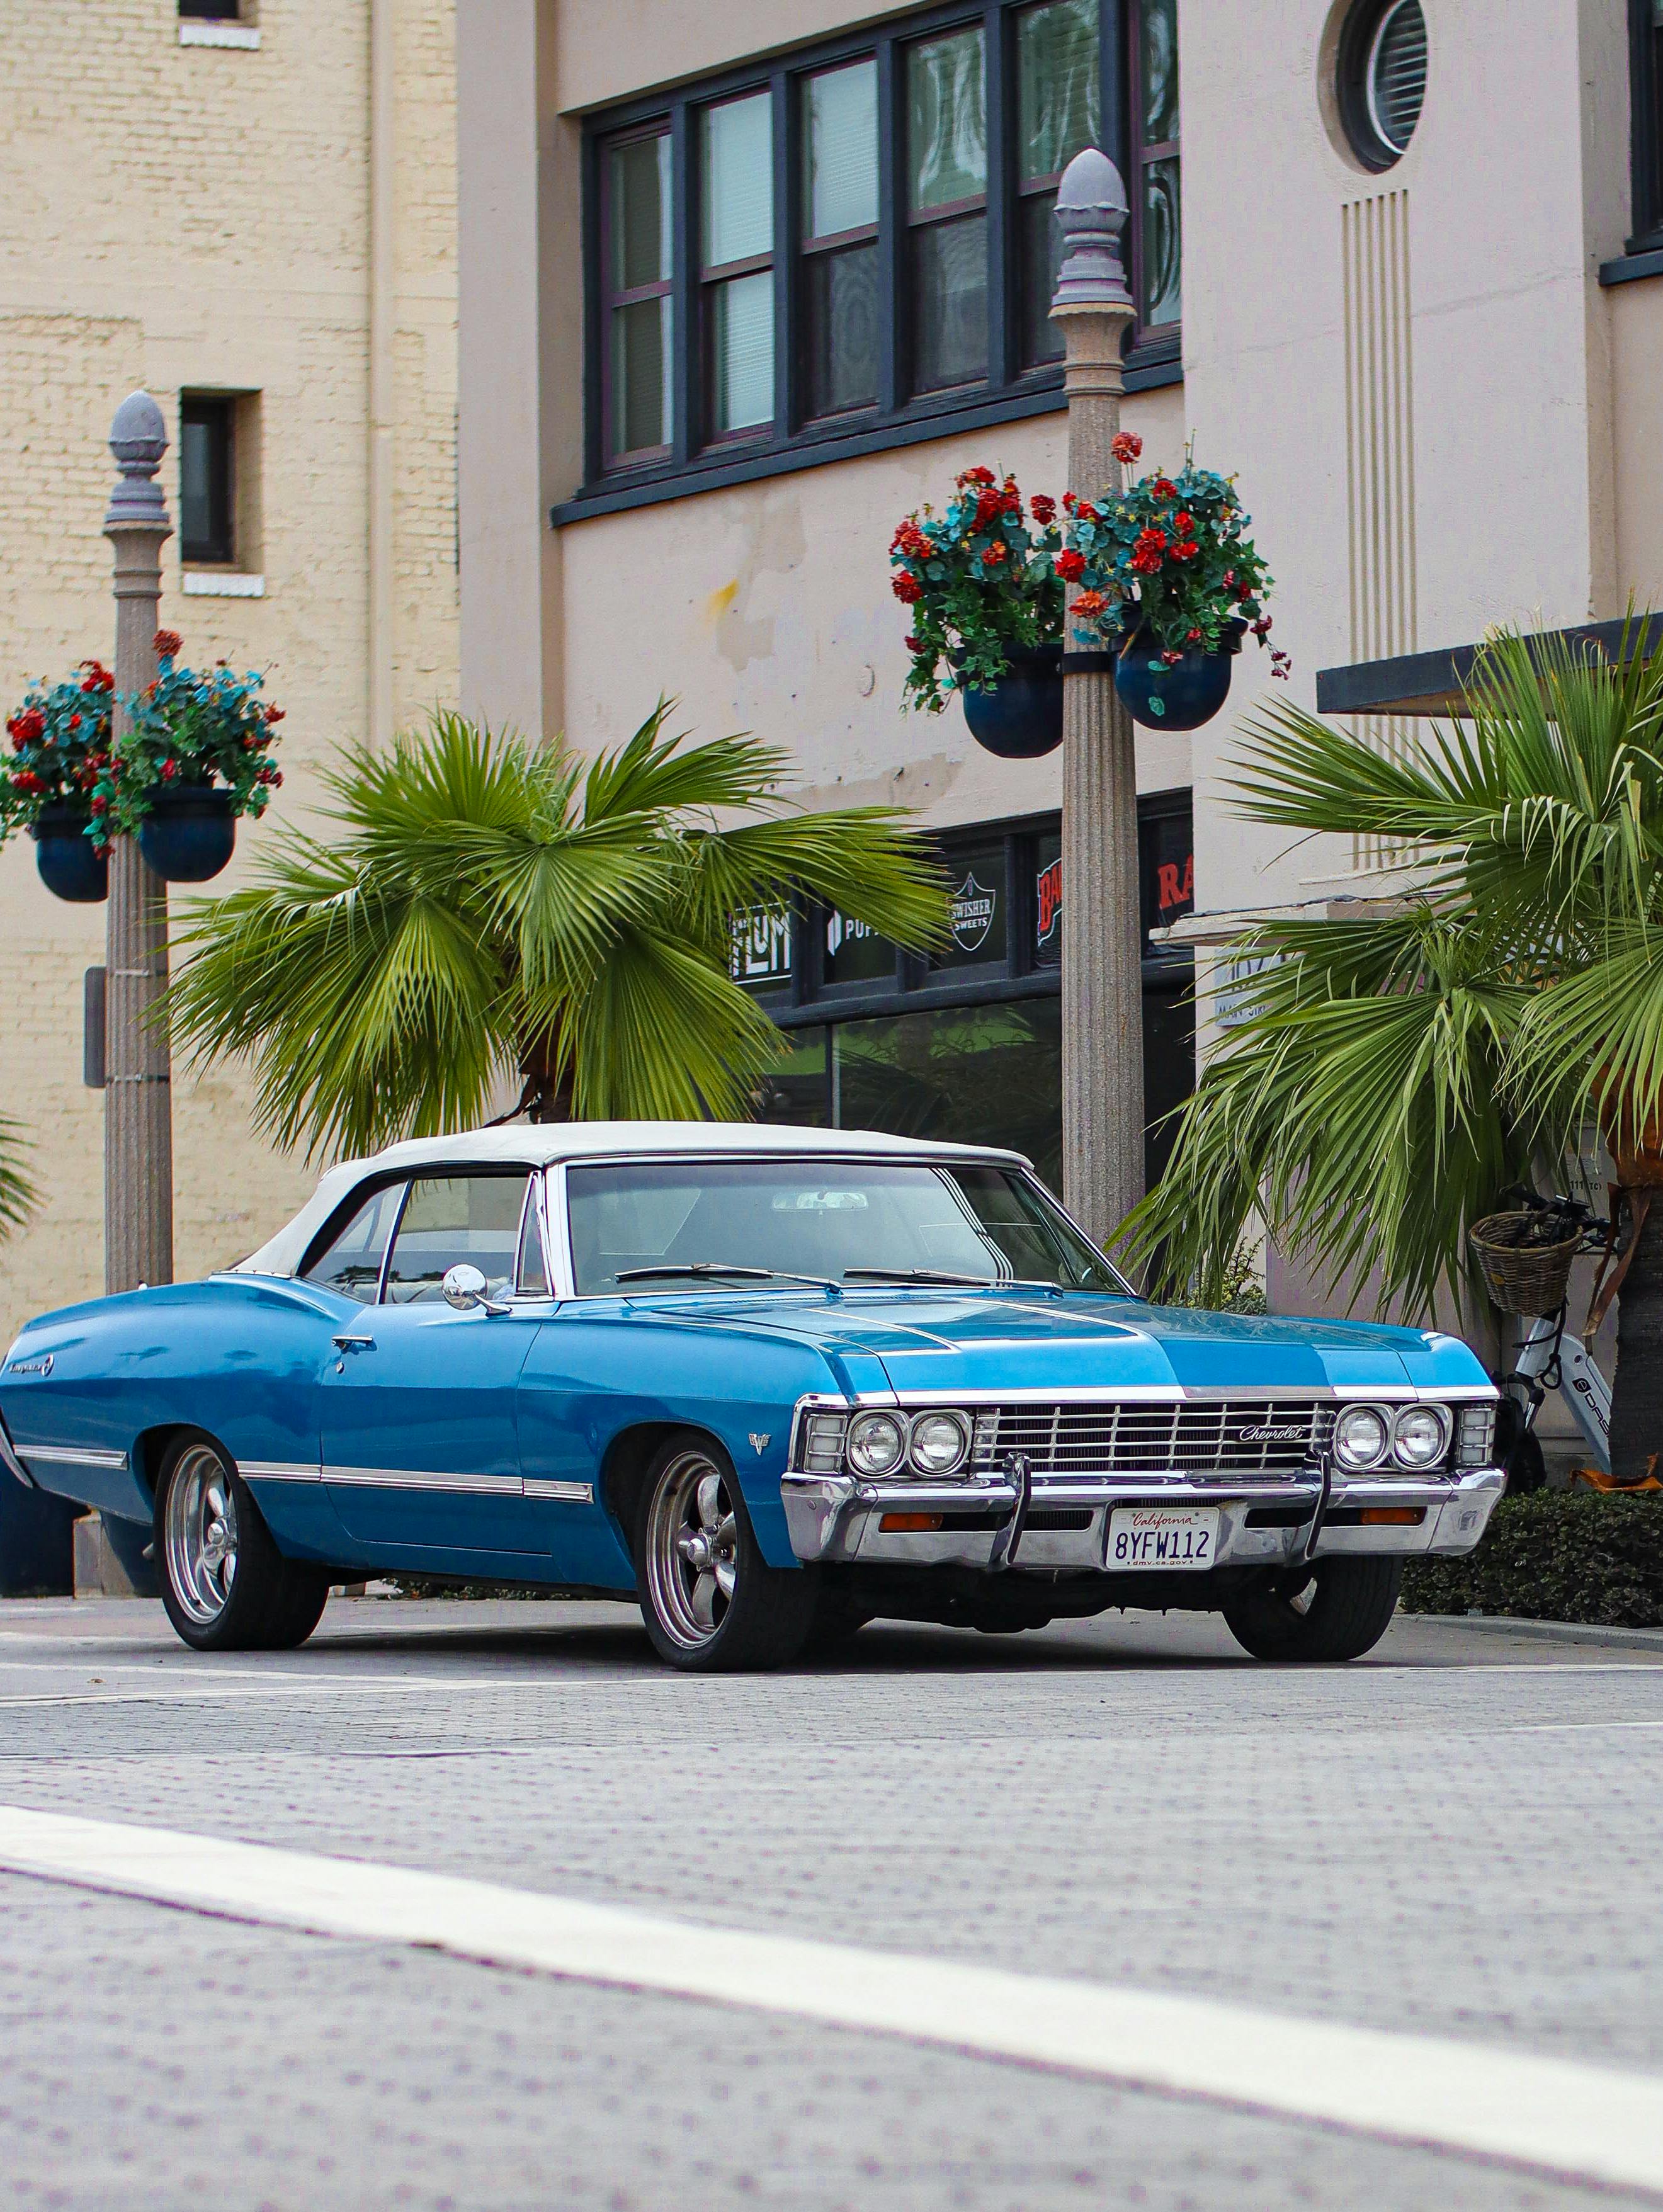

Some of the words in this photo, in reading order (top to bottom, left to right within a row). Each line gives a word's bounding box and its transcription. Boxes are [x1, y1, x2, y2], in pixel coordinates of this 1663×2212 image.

[1040, 862, 1062, 932] BA
[955, 917, 988, 931] SWEETS
[1584, 1392, 1609, 1438] DAS
[1239, 1425, 1306, 1441] Chevrolet
[1133, 1512, 1198, 1530] California
[1115, 1531, 1210, 1559] 8YFW112
